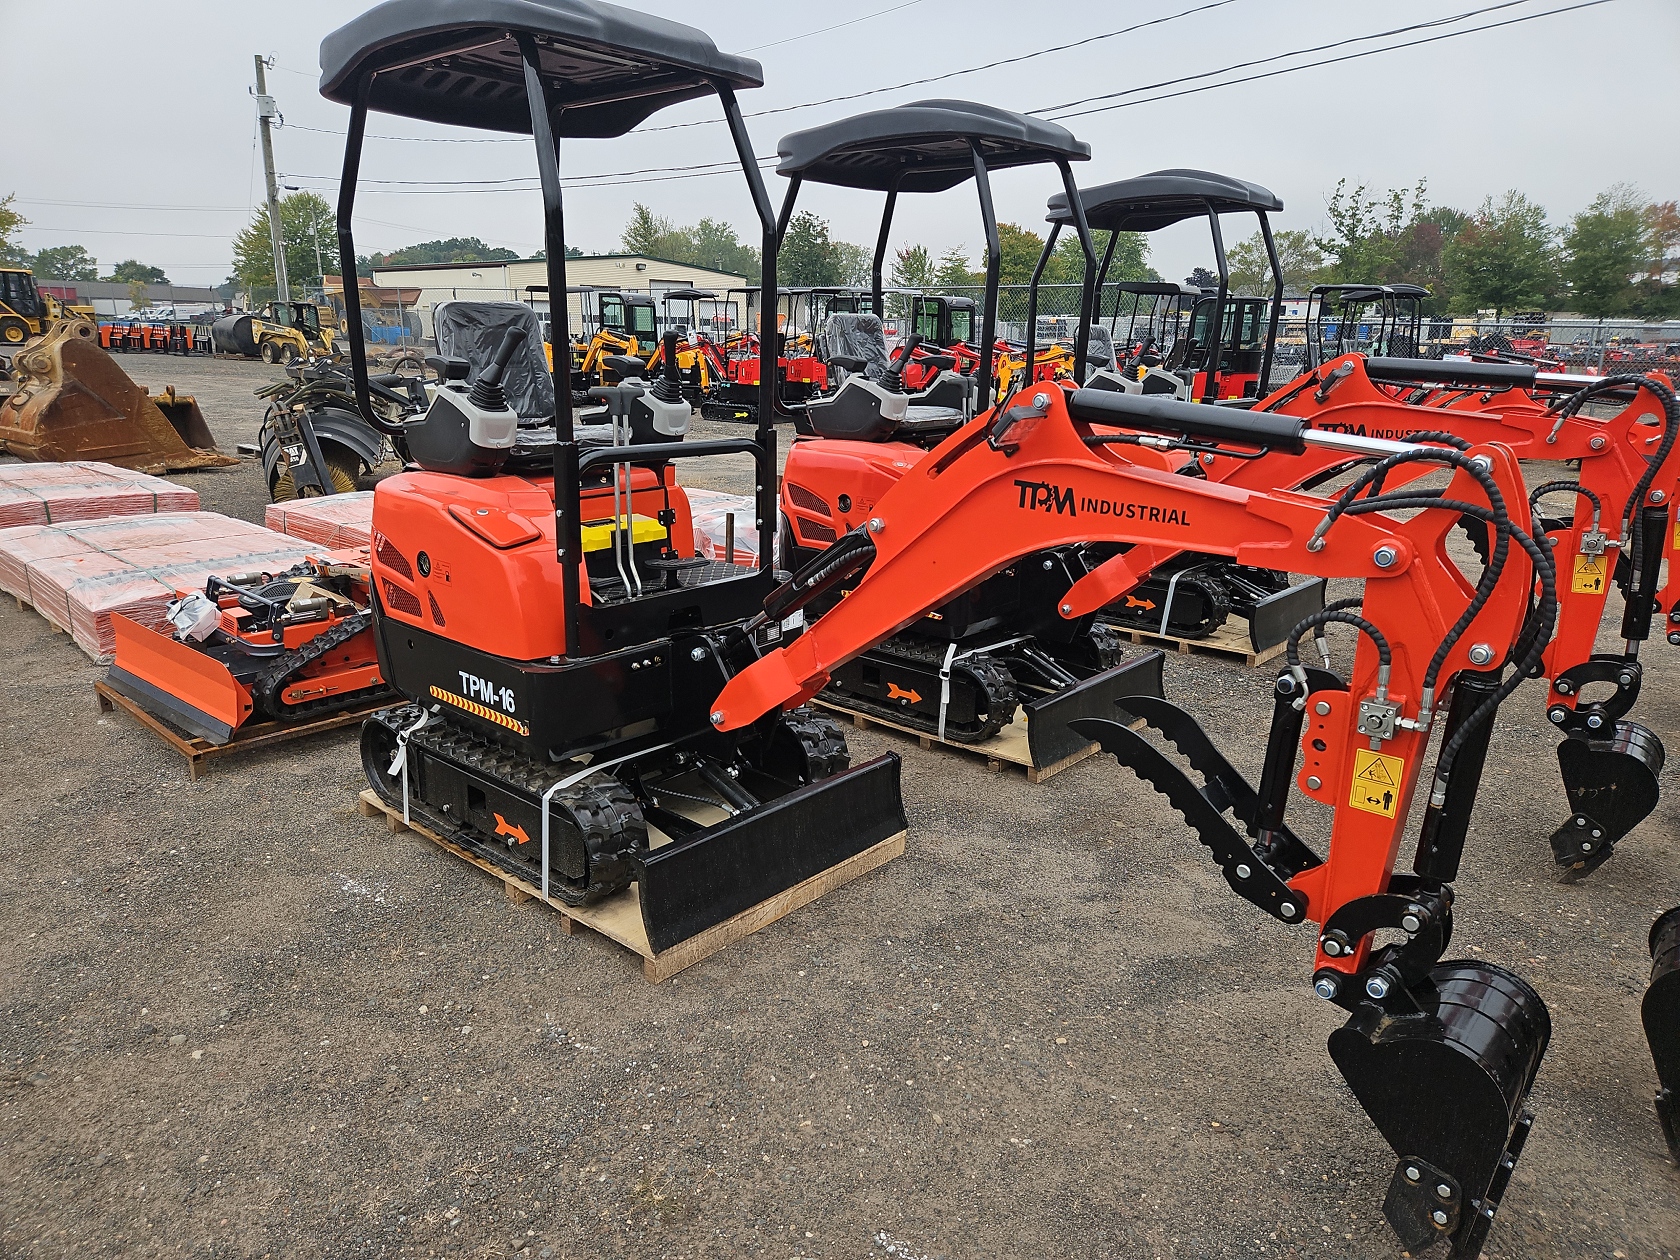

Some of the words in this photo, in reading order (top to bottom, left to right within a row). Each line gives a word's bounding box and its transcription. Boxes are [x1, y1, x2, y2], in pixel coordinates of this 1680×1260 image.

[1014, 479, 1077, 517] TPM
[1080, 497, 1191, 527] INDUSTRIAL
[458, 670, 516, 713] TPM-16
